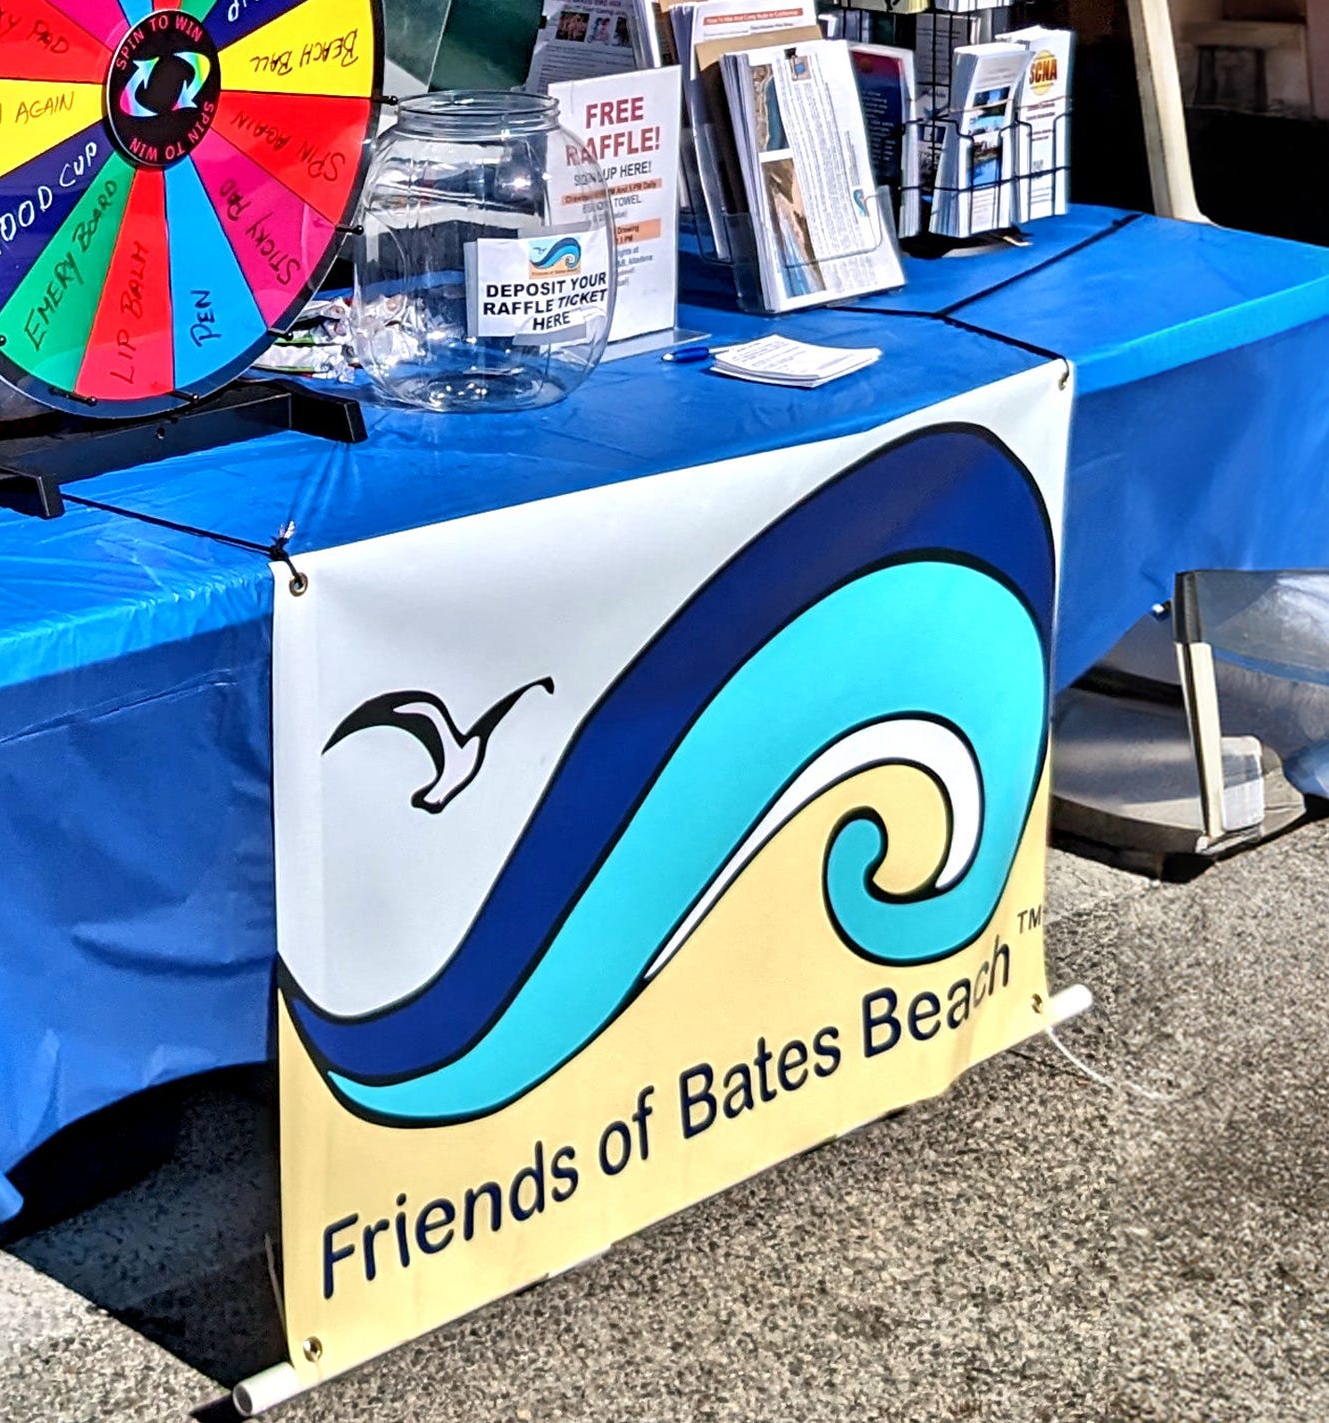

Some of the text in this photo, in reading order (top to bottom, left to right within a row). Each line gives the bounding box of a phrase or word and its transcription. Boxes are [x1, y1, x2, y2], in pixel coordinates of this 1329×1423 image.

[26, 19, 70, 55] PAD
[116, 15, 203, 70] SPIN TO WIN
[250, 28, 359, 76] BEACH BALL
[15, 91, 75, 125] AGAIN
[129, 101, 214, 162] SPIN TO WIN
[585, 96, 644, 129] FREE
[59, 141, 97, 188] CUP
[230, 111, 346, 182] SPIN AGAIN
[565, 126, 661, 167] RAFFLE!
[602, 166, 617, 181] UP
[619, 160, 652, 178] HERE!
[614, 194, 642, 209] TOWEL
[219, 178, 301, 286] STICKY PAD
[23, 180, 118, 353] EMERY BOARD
[486, 280, 566, 298] DEPOSIT
[570, 271, 607, 291] YOUR
[109, 240, 150, 385] LIP BALM
[190, 289, 222, 348] PEN
[483, 288, 608, 315] RAFFLE TICKET
[532, 310, 571, 331] HERE
[321, 906, 1044, 1301] Friends of Bates Beach TM
